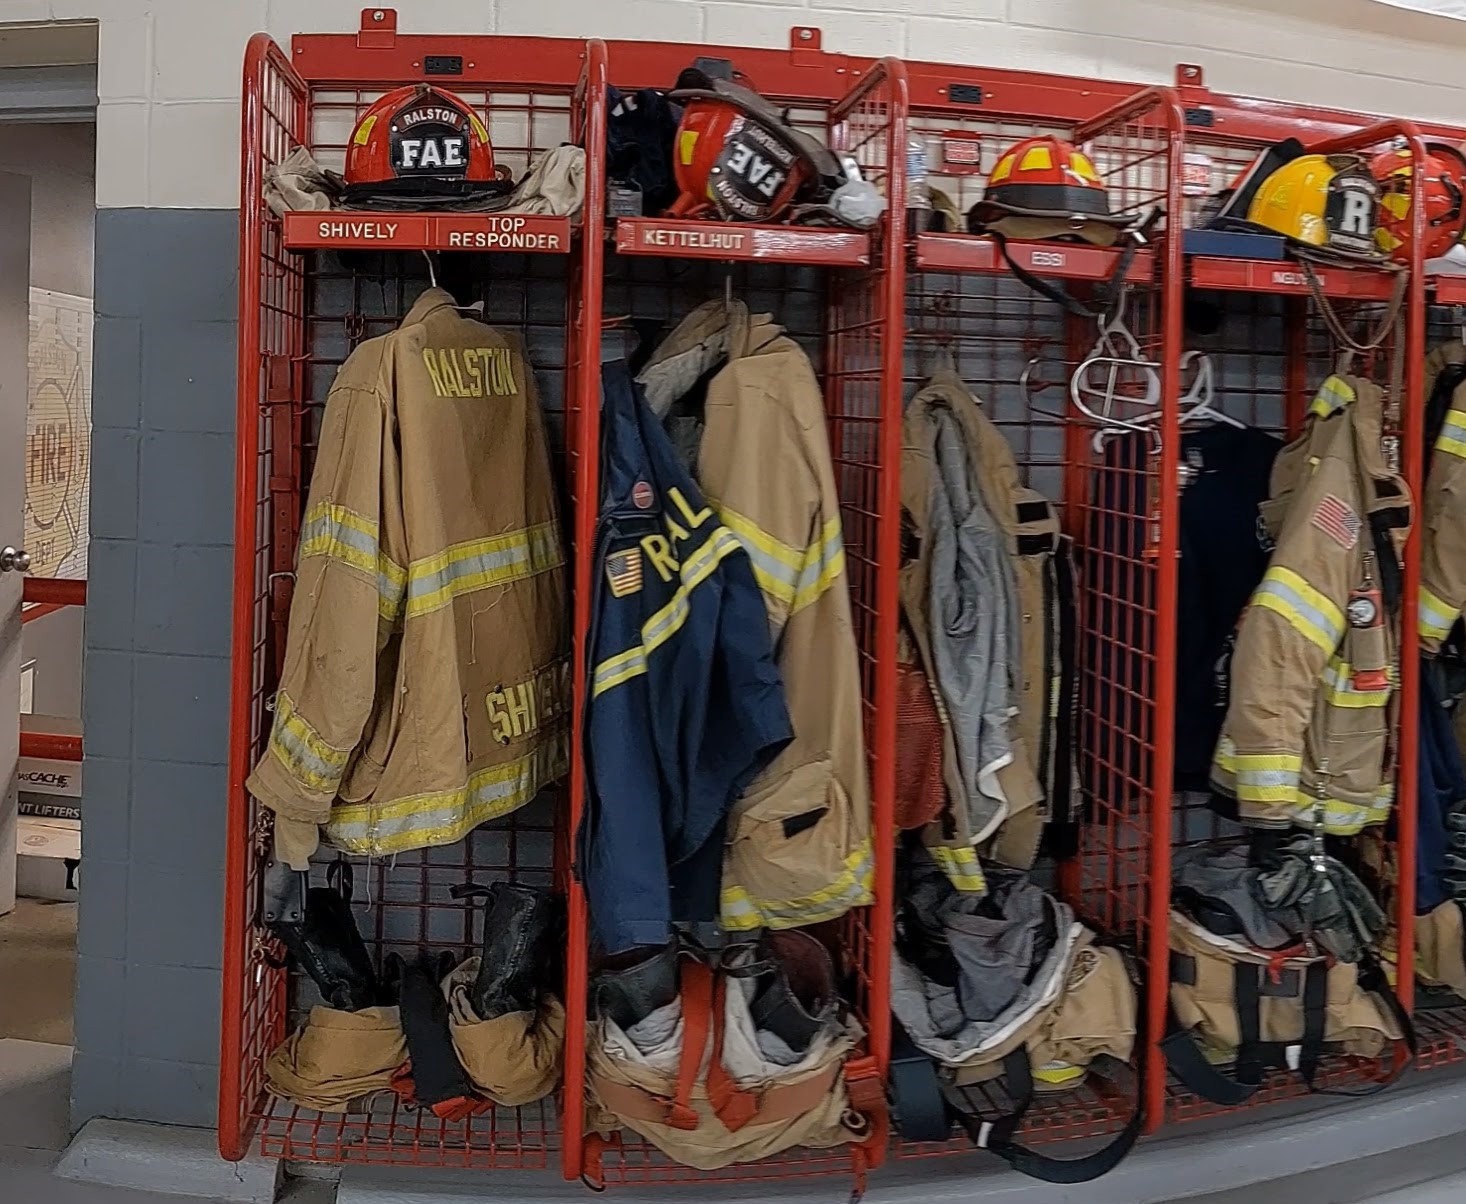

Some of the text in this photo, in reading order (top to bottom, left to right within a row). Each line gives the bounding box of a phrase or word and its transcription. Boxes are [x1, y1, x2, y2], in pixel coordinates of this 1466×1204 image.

[403, 107, 457, 126] RALSTON
[401, 138, 462, 167] FAE
[727, 140, 786, 197] FAE
[1341, 190, 1372, 235] R
[318, 222, 399, 239] SHIVELY
[488, 217, 526, 232] TOP
[449, 232, 560, 249] RESPONDER
[643, 229, 746, 250] KETTELHUT
[422, 347, 519, 398] RALSTON
[34, 803, 81, 819] LIFTERS
